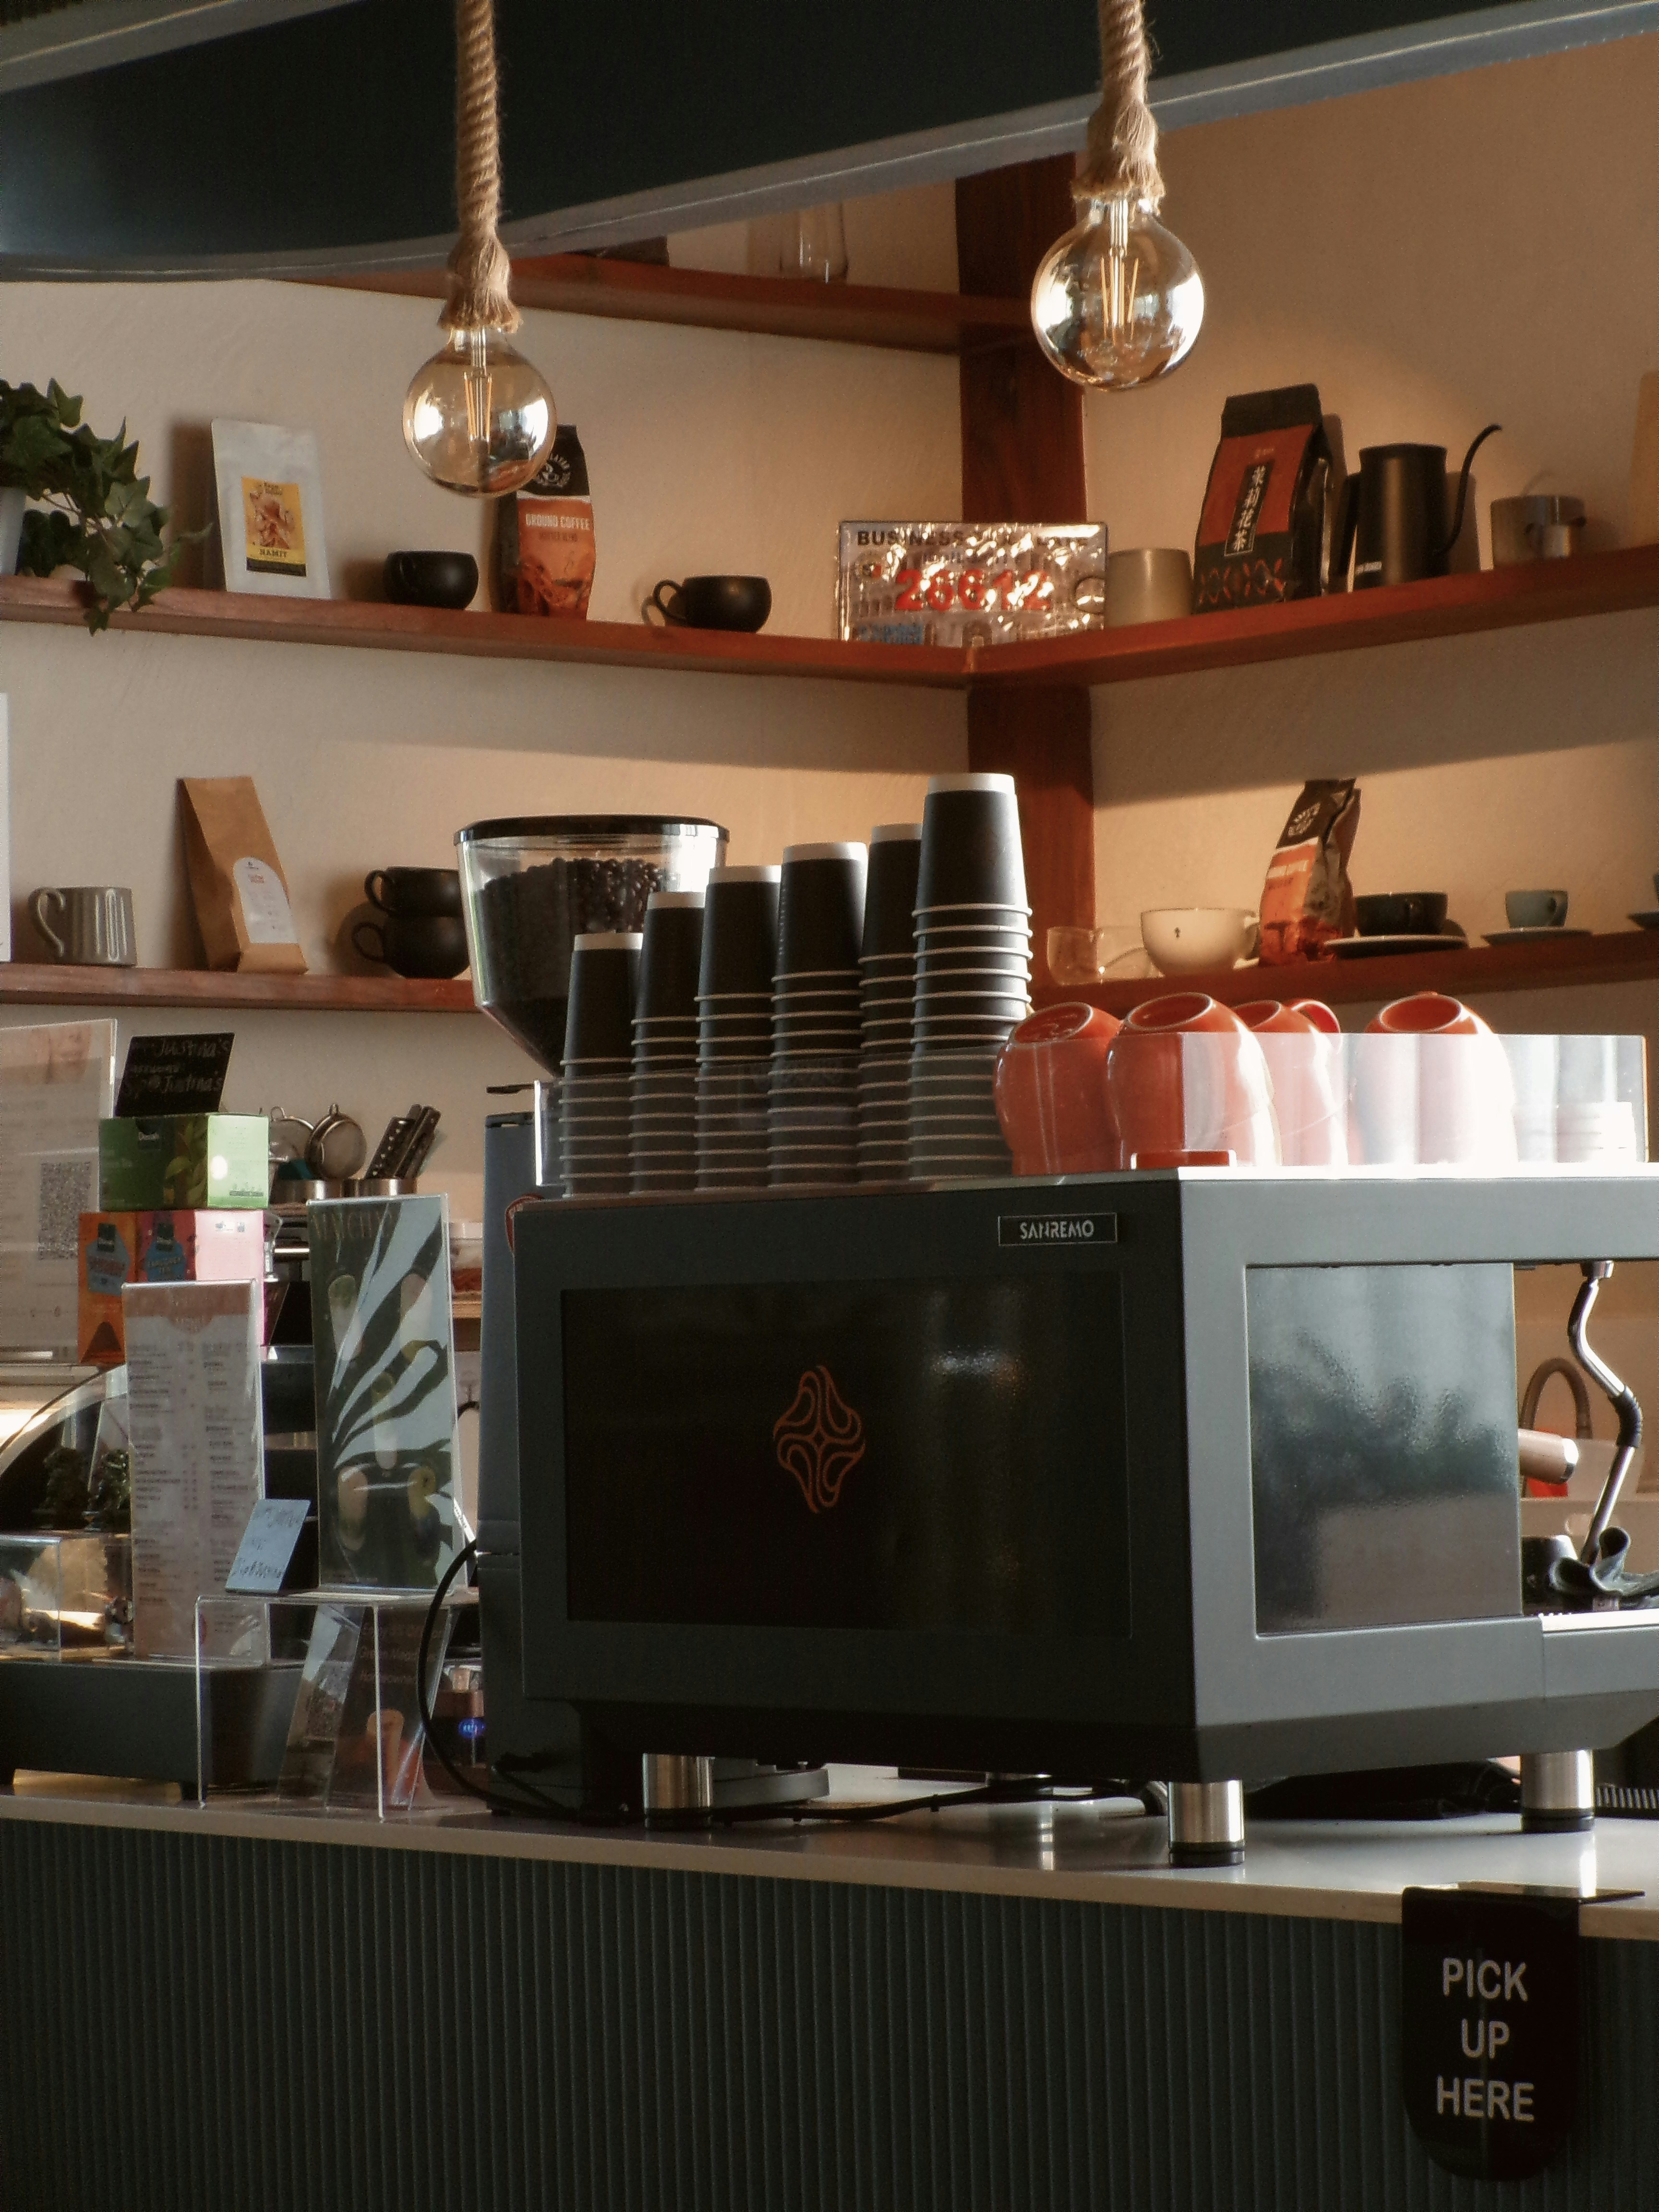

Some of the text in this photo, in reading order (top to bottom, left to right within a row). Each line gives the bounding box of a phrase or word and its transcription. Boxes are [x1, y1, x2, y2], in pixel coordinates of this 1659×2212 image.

[560, 516, 590, 531] COFFEE
[895, 568, 1052, 612] 26612
[1020, 1219, 1095, 1240] SANREMO
[1442, 1957, 1529, 2002] PICK
[1461, 2018, 1510, 2060] UP
[1436, 2074, 1536, 2124] HERE
